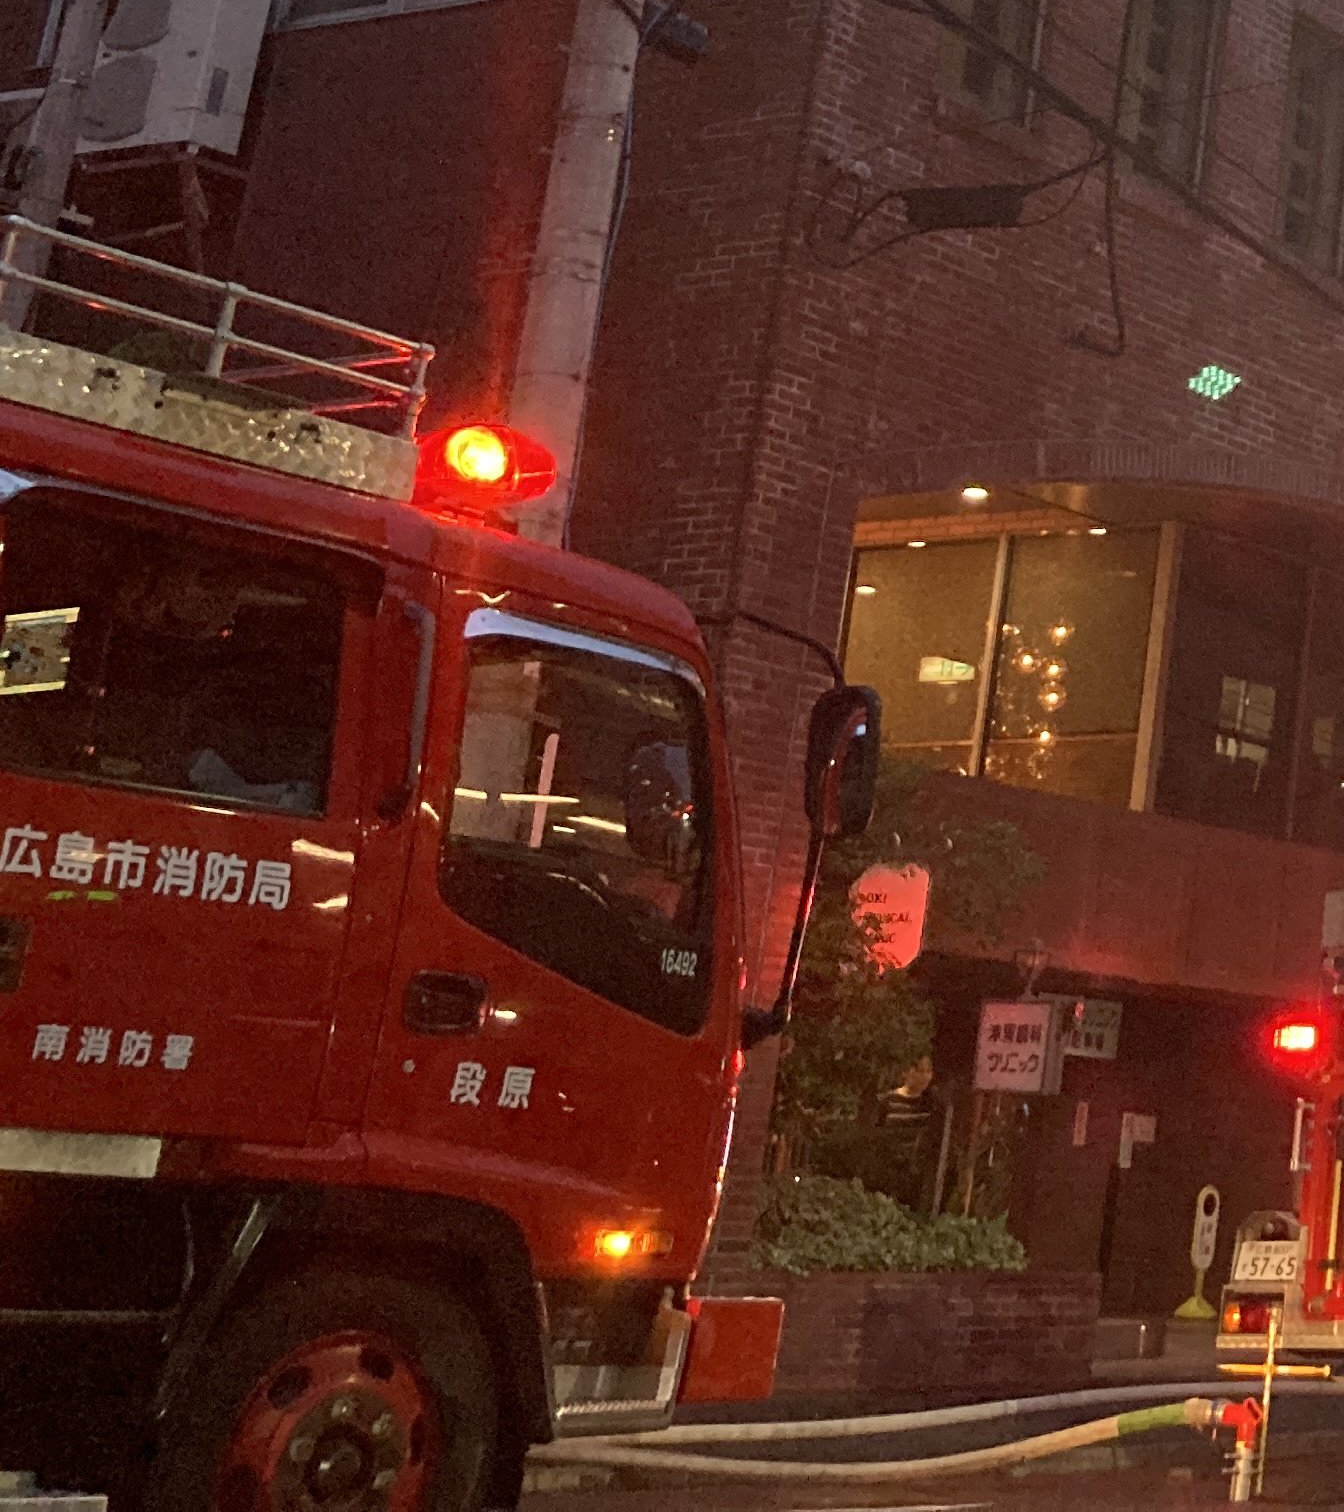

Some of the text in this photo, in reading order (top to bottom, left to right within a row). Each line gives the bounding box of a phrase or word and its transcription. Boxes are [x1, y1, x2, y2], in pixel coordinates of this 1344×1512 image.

[0, 823, 293, 912] 広島市消防局
[859, 891, 888, 904] OKI
[660, 947, 698, 977] 16492
[31, 1023, 195, 1072] 南消防署
[448, 1061, 536, 1110] 段原
